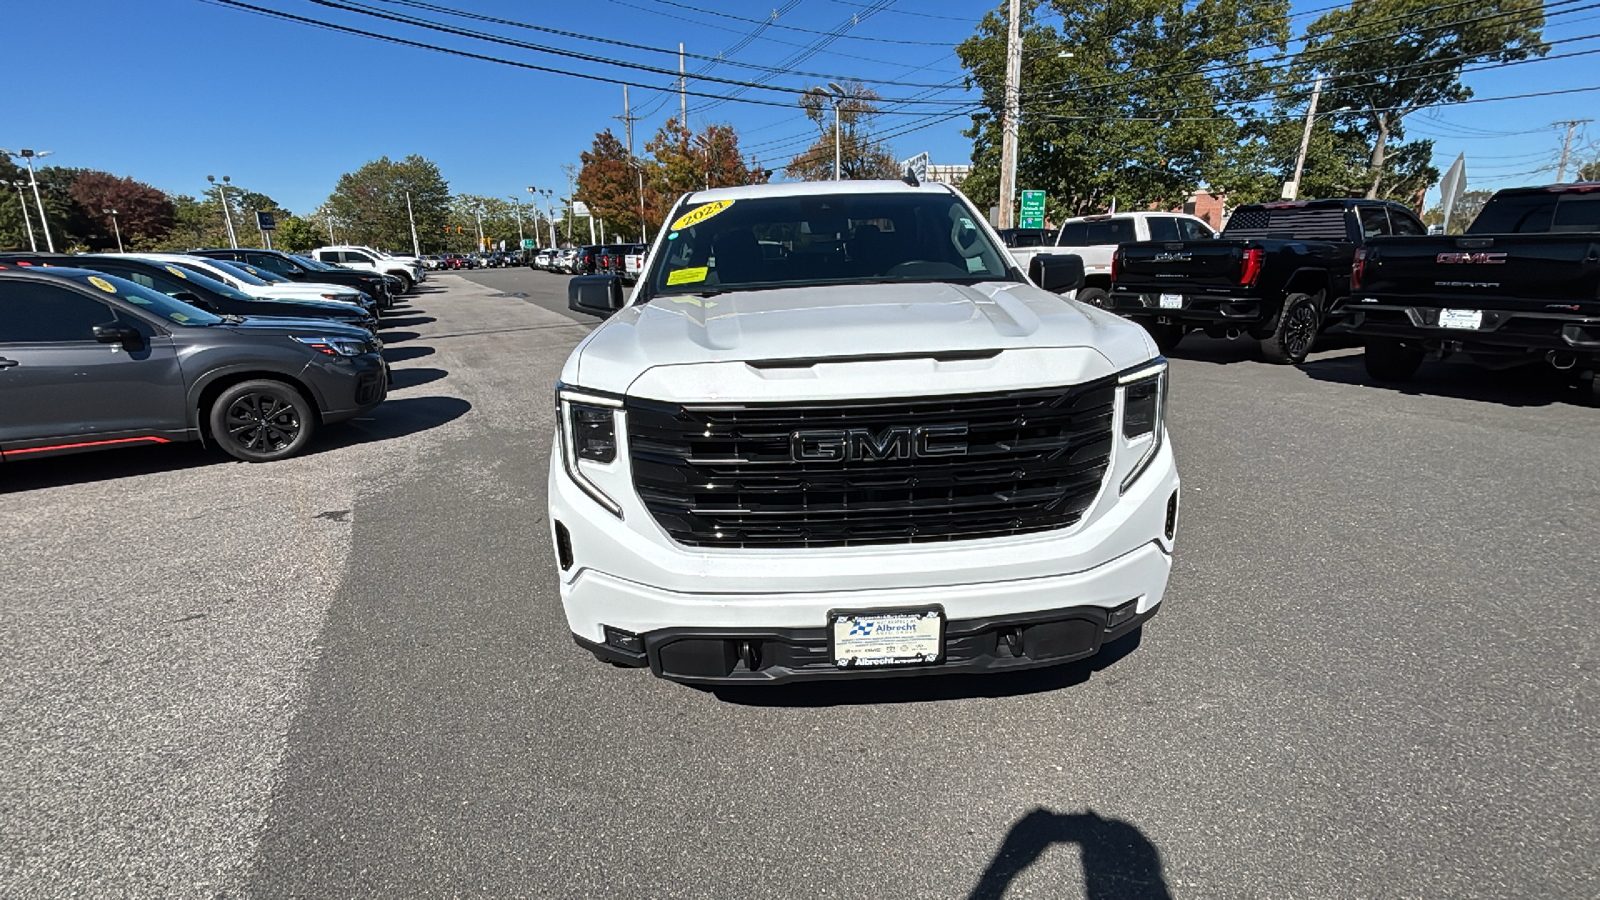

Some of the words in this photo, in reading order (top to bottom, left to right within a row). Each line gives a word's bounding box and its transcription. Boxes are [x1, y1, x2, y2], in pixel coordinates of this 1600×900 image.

[683, 201, 724, 226] 2024
[1436, 252, 1508, 264] GMC
[790, 421, 969, 463] GMC
[875, 622, 917, 632] Albrecht
[855, 657, 894, 666] Albrecht
